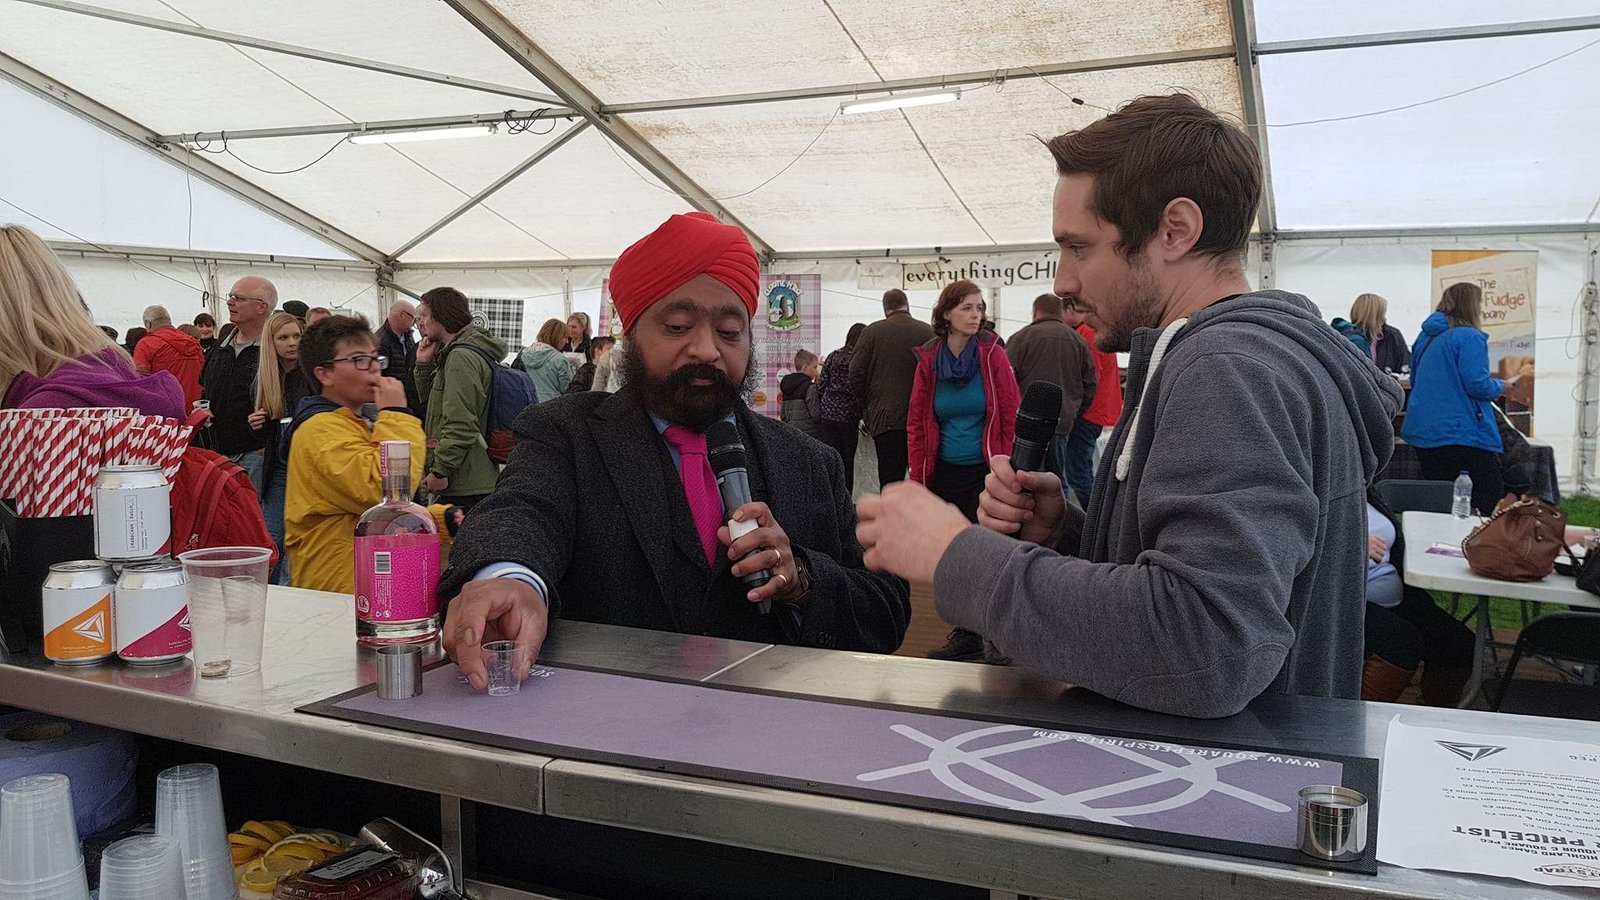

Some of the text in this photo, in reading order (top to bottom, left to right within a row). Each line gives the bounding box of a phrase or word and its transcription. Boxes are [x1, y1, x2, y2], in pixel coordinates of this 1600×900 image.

[1478, 279, 1496, 289] The
[1484, 292, 1525, 310] Fudge
[1452, 826, 1585, 846] PRICELIST
[1501, 846, 1598, 860] HIGHLAND GAMES
[1505, 842, 1547, 850] SQUARE
